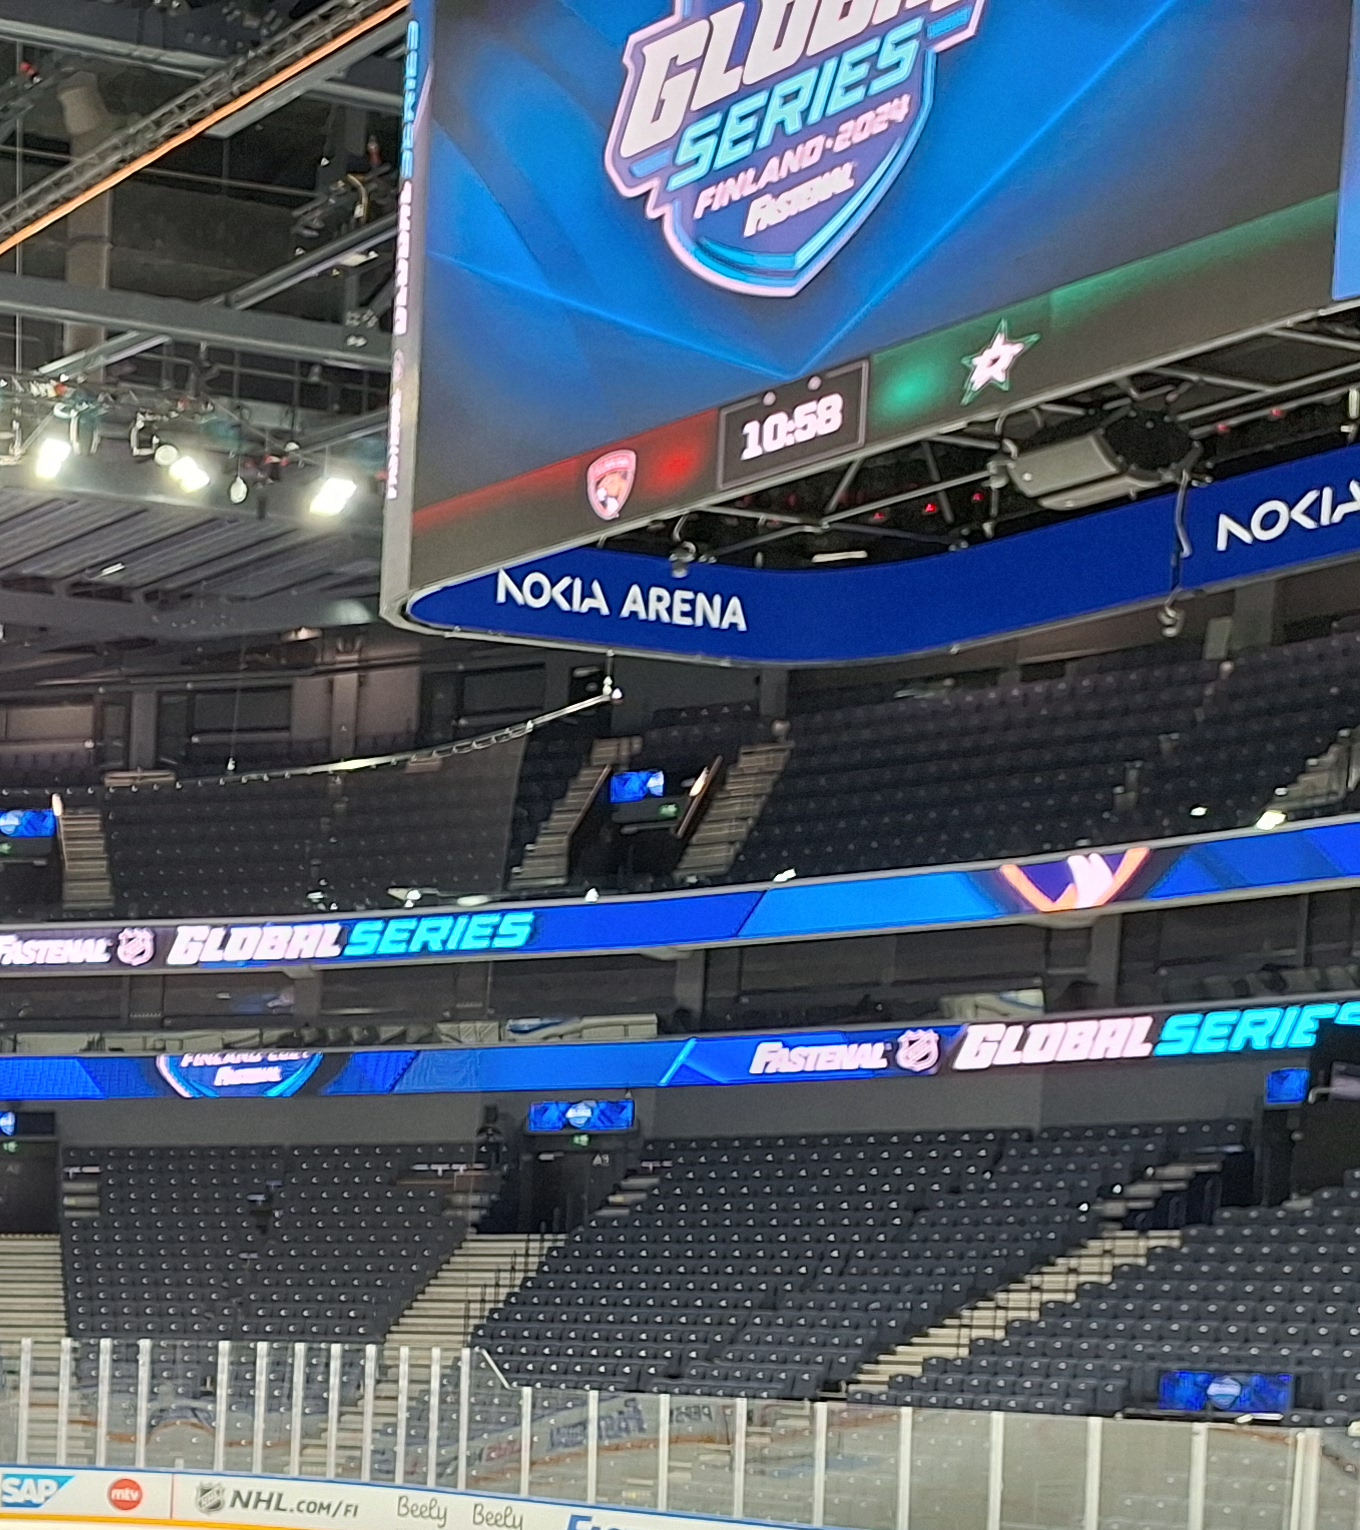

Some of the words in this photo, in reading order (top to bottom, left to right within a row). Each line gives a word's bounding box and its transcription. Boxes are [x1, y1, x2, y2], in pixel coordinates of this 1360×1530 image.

[620, 0, 962, 158] GLOB
[667, 16, 925, 191] SERIES
[693, 134, 826, 219] FINLAND
[833, 93, 911, 154] 2024
[741, 393, 843, 460] 10:58
[1217, 479, 1360, 551] NOKIA
[495, 568, 610, 616] NOKIA
[619, 584, 747, 632] ARENA
[166, 922, 343, 966] GLOBAL
[343, 911, 535, 957] SERIES
[748, 1041, 888, 1075] FASTENAL
[953, 1015, 1155, 1070] GLOBAL
[1, 1476, 59, 1504] SAP
[111, 1486, 140, 1502] mtv
[230, 1489, 359, 1518] NHL.COM/FI
[397, 1495, 448, 1529] Beely
